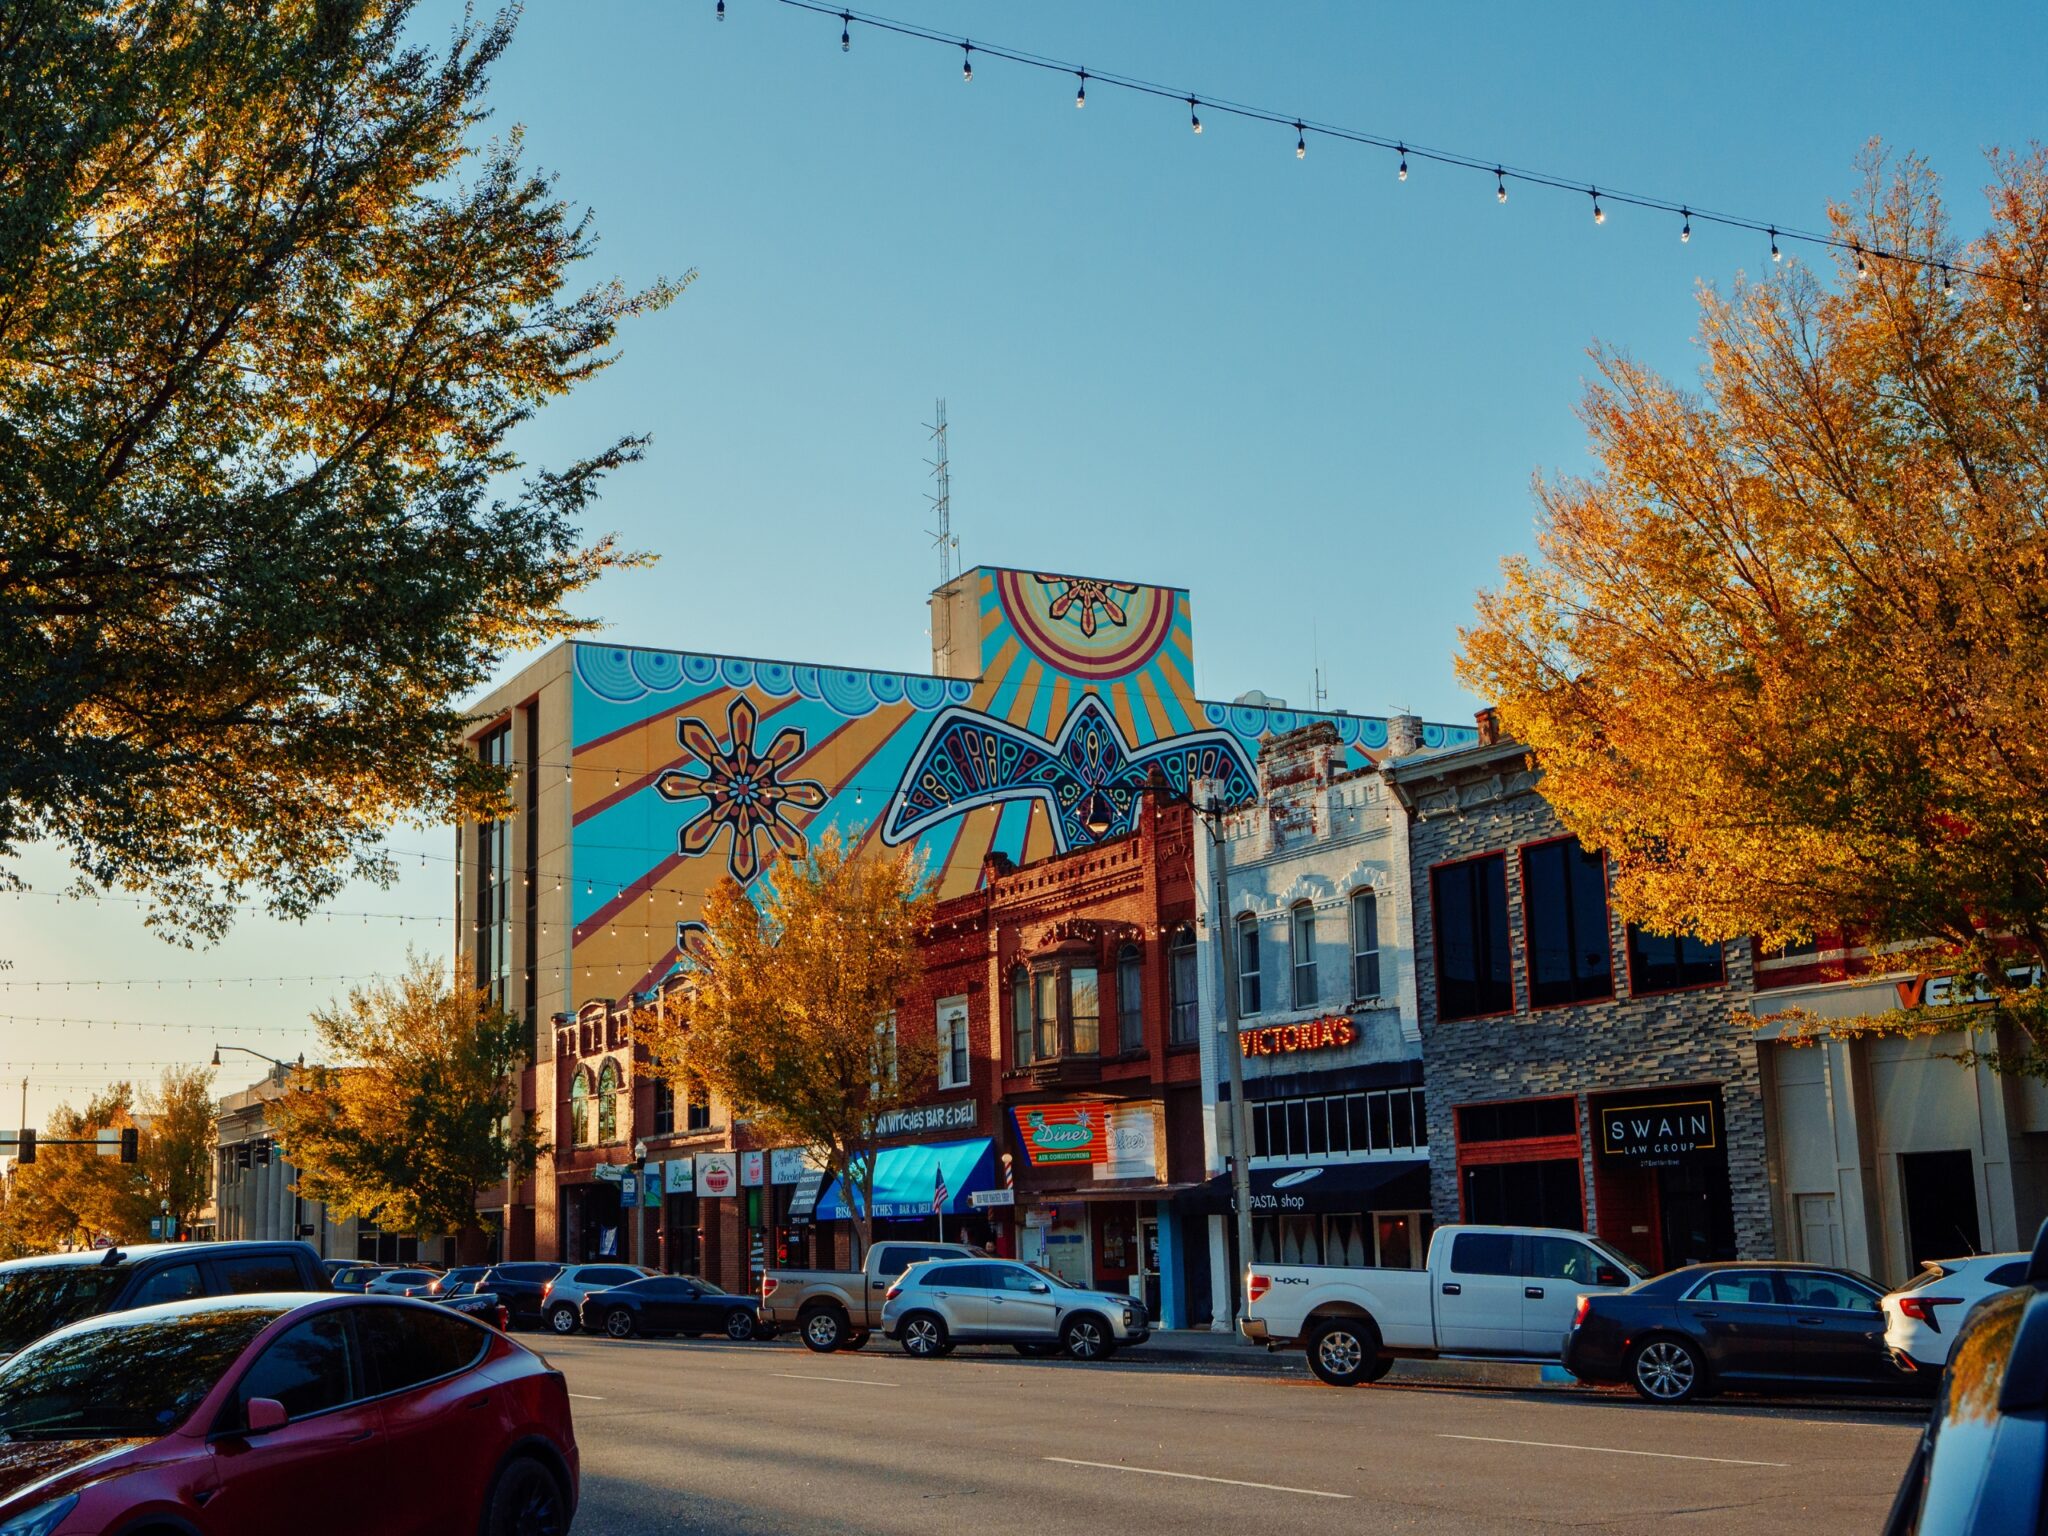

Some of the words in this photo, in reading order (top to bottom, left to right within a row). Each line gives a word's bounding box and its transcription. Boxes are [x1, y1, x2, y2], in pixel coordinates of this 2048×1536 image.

[1238, 1015, 1353, 1058] VICTORIA'S
[887, 1111, 924, 1133] WITCHES
[926, 1107, 944, 1128] BAR
[946, 1106, 954, 1125] &
[954, 1103, 974, 1124] DELI
[1611, 1115, 1706, 1140] SWAIN
[1037, 1123, 1090, 1143] Diner
[1107, 1126, 1144, 1150] Diner
[1049, 1151, 1090, 1160] CONDITIONING
[1624, 1145, 1648, 1155] LAW
[1654, 1142, 1695, 1153] GROUP
[861, 1203, 893, 1217] WTCHES
[899, 1204, 910, 1214] BAR
[918, 1203, 931, 1214] DELI
[1250, 1195, 1278, 1209] PASTA
[1281, 1193, 1305, 1211] shop
